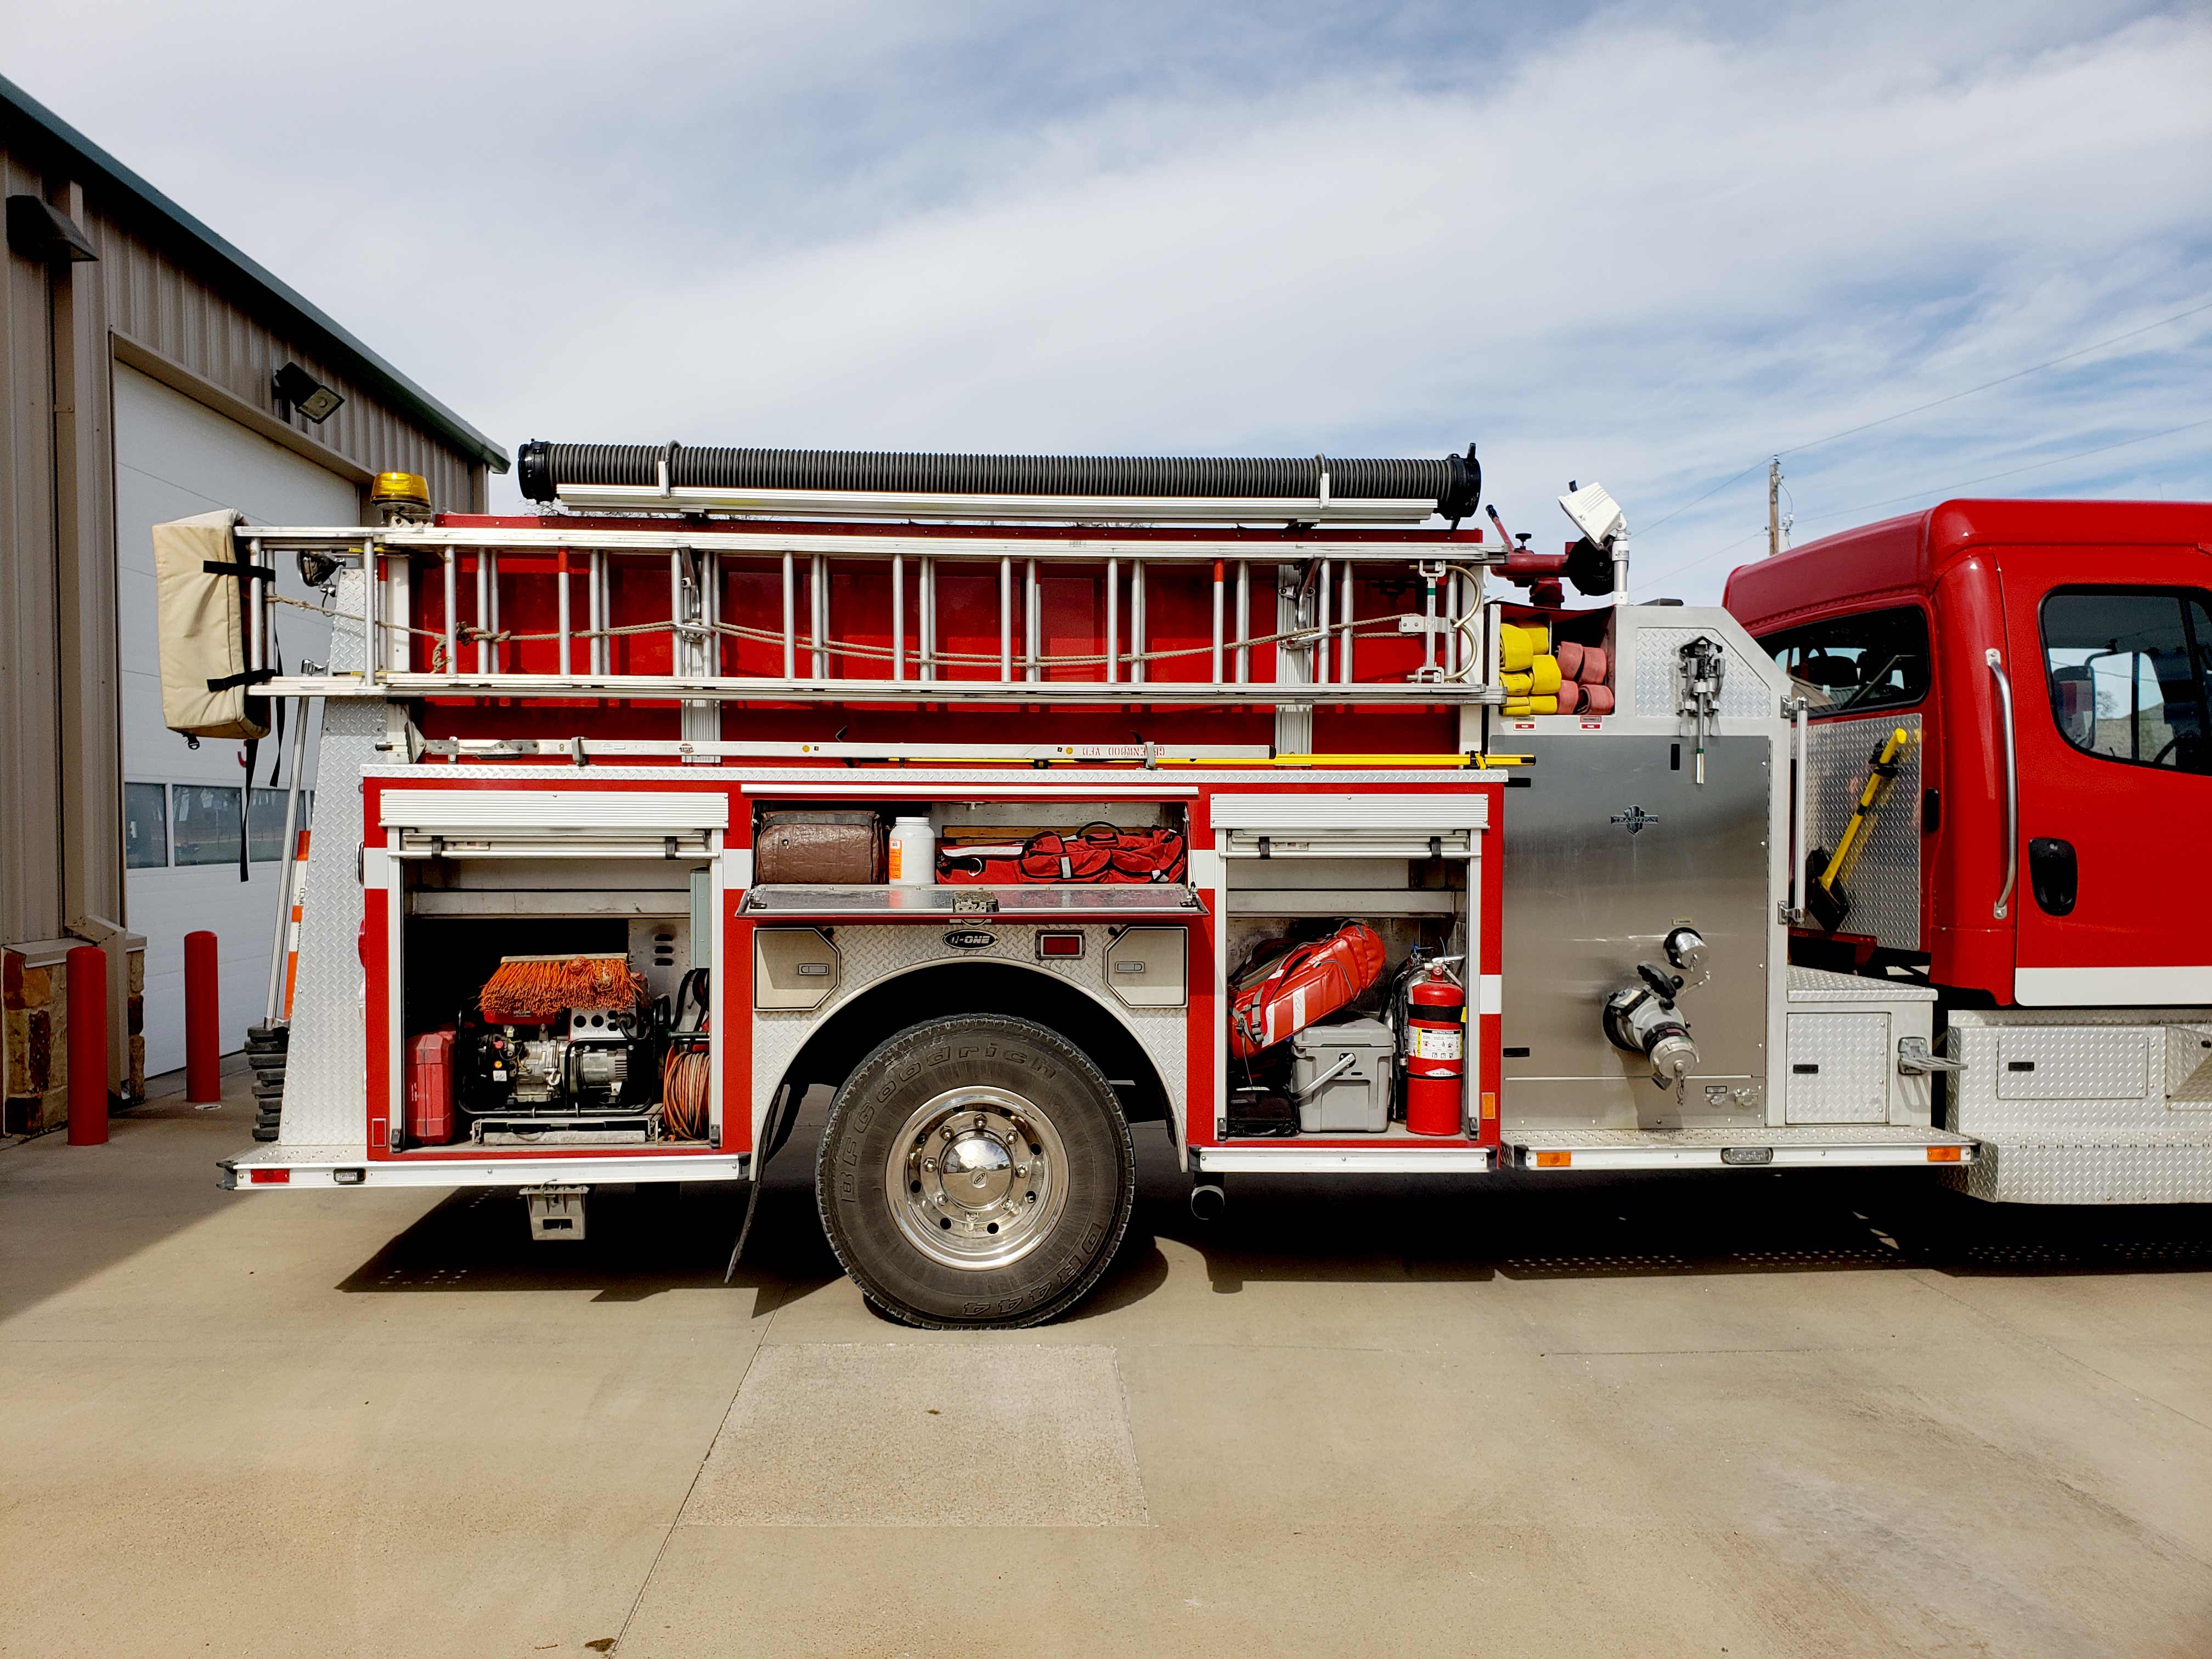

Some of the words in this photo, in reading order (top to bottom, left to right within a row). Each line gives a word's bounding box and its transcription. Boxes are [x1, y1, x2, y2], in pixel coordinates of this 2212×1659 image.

[1082, 747, 1101, 756] VFD
[1108, 747, 1165, 756] GRENWOOD
[841, 1043, 1058, 1203] BFGoodrich
